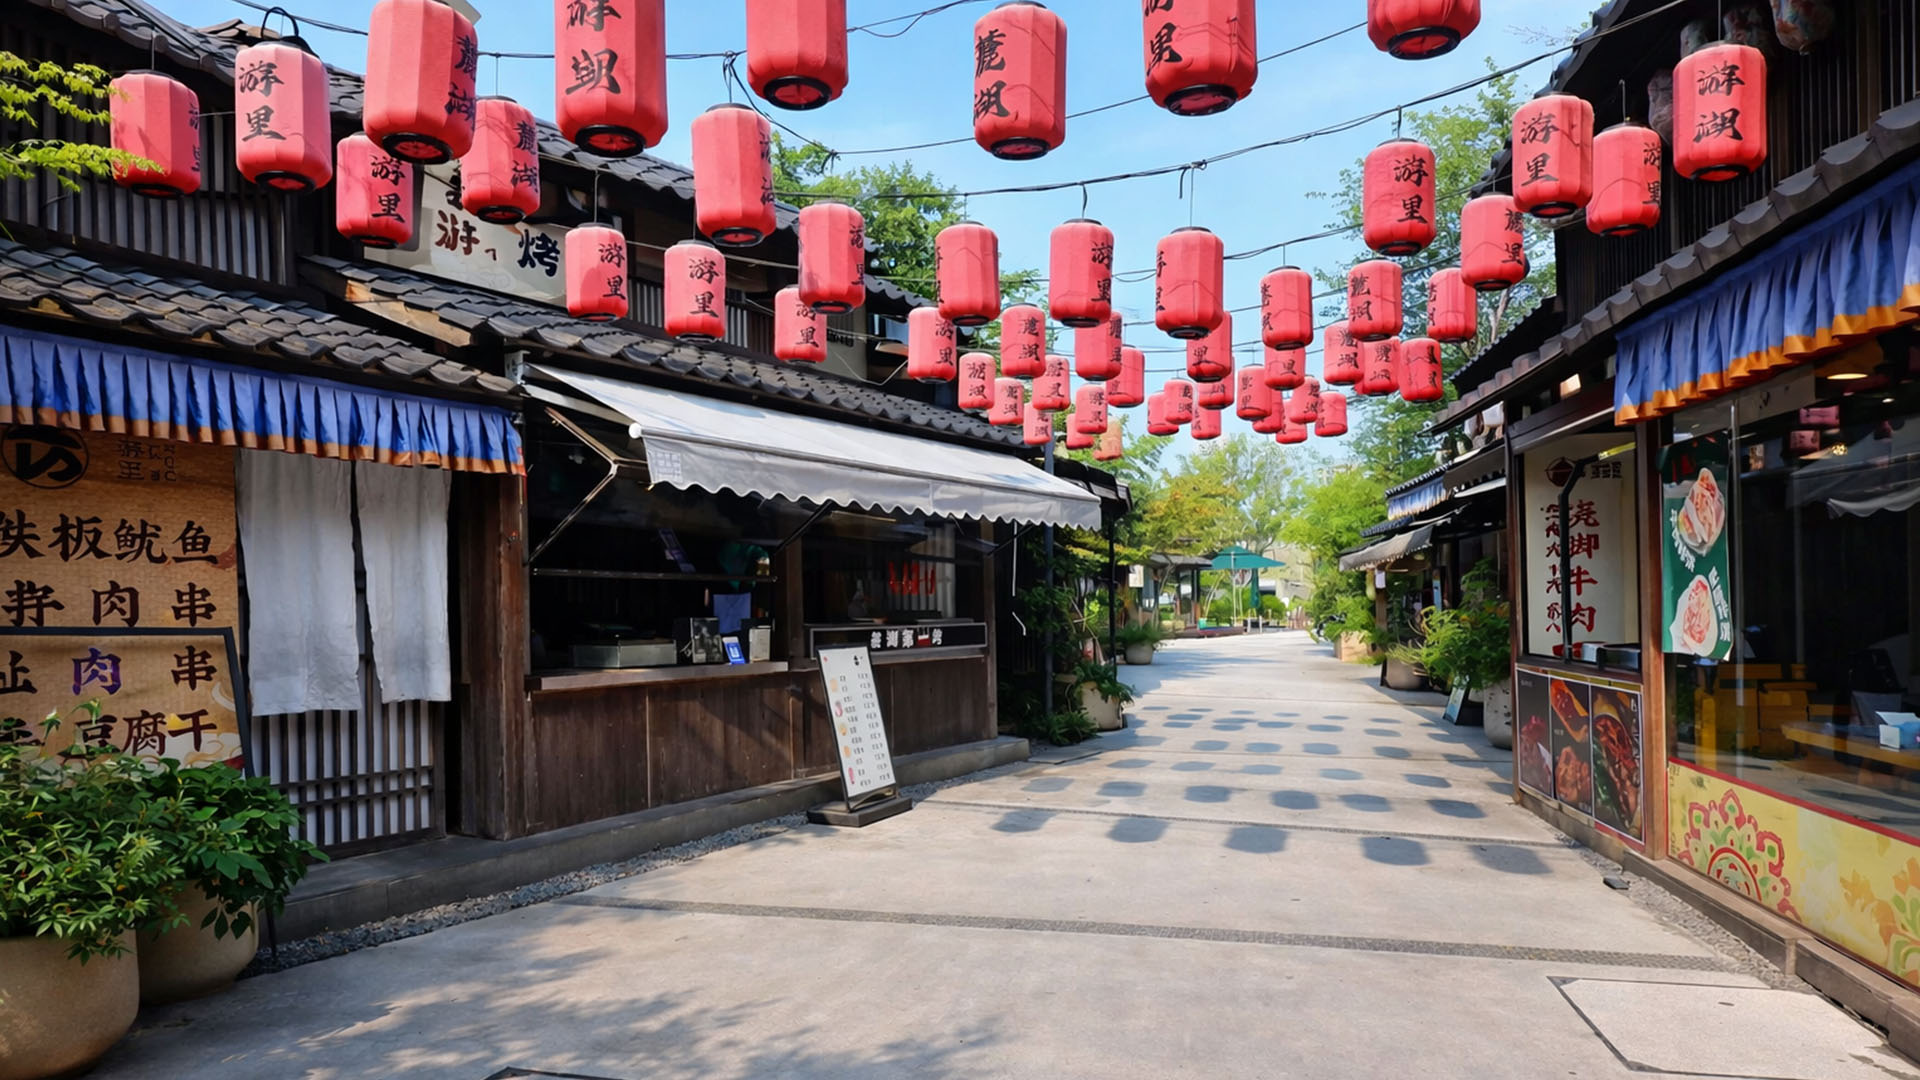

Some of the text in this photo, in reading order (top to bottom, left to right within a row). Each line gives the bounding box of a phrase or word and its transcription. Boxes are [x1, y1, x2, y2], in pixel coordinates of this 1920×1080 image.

[238, 59, 287, 142] 游里
[1521, 111, 1558, 187] 游里
[370, 154, 405, 223] 游里
[1394, 153, 1428, 225] 游里
[598, 243, 626, 300] 游里
[688, 258, 720, 318] 游里
